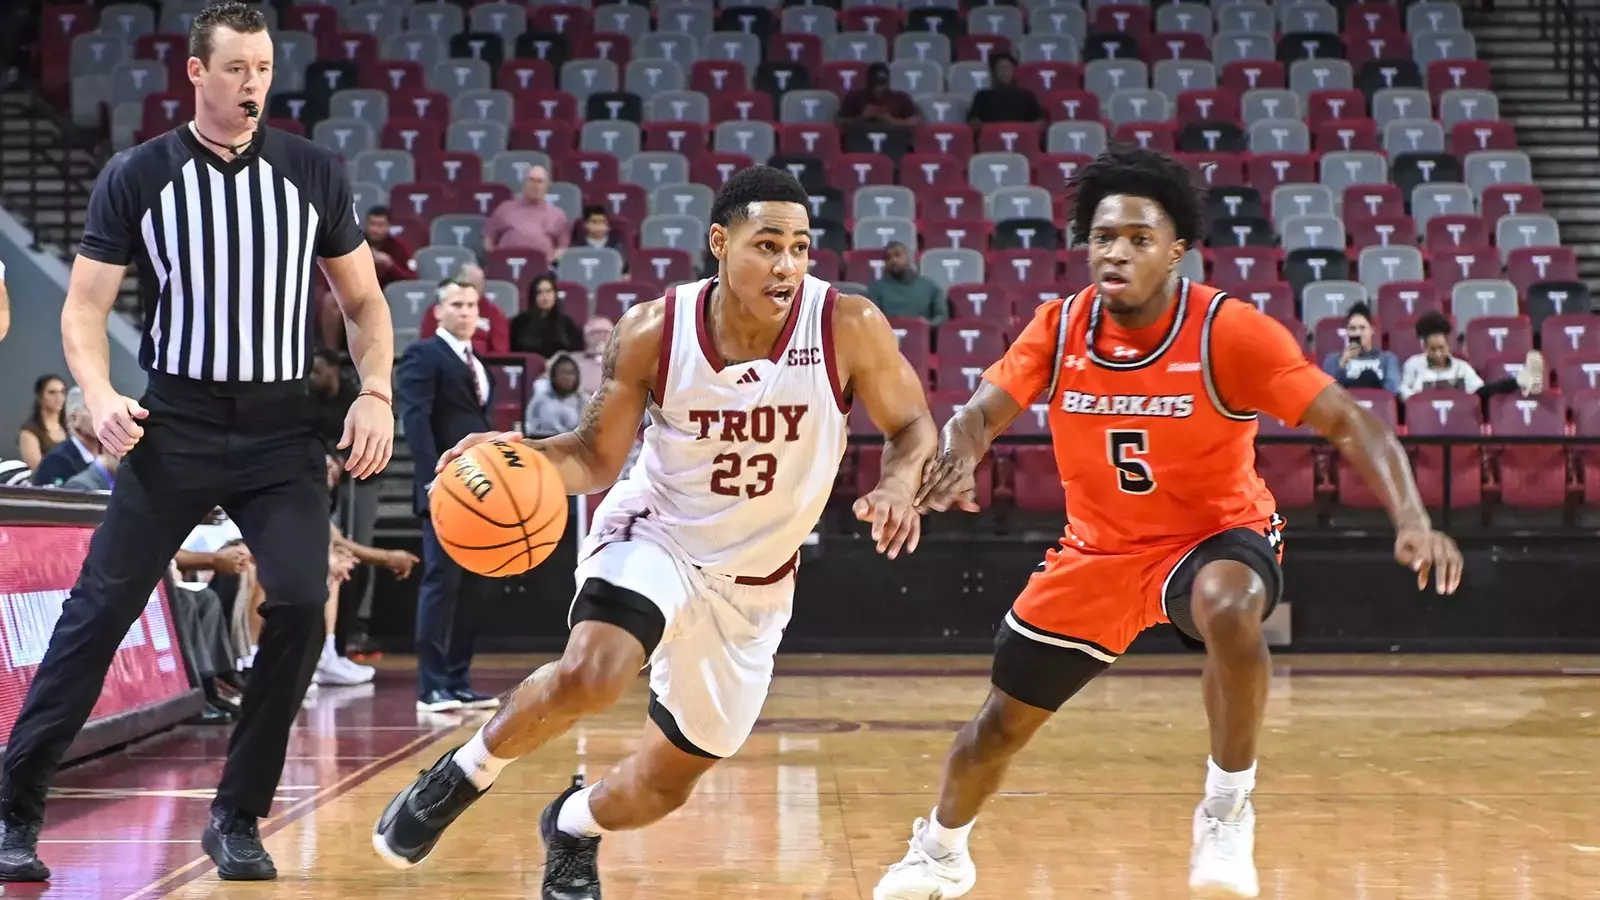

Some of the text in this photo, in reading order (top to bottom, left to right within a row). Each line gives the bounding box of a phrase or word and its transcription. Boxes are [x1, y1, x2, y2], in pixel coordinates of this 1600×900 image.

[131, 69, 148, 88] T
[324, 70, 341, 89] T
[389, 70, 405, 88] T
[454, 67, 471, 85] T
[516, 69, 533, 88] T
[581, 69, 597, 87] T
[645, 68, 662, 86] T
[711, 70, 728, 89] T
[774, 70, 792, 89] T
[839, 70, 857, 89] T
[905, 70, 922, 89] T
[970, 71, 988, 88] T
[1039, 70, 1056, 89] T
[1107, 69, 1125, 87] T
[1177, 69, 1193, 87] T
[1244, 68, 1262, 87] T
[1312, 68, 1330, 87] T
[1380, 68, 1398, 87] T
[1449, 68, 1467, 87] T
[162, 100, 179, 119] T
[287, 100, 305, 119] T
[351, 99, 367, 118] T
[413, 98, 430, 117] T
[475, 99, 493, 120] T
[540, 100, 557, 119] T
[605, 100, 624, 119] T
[671, 101, 689, 119] T
[736, 101, 754, 120] T
[801, 98, 819, 117] T
[932, 102, 950, 121] T
[1063, 100, 1081, 119] T
[1129, 98, 1147, 117] T
[1196, 99, 1213, 118] T
[1263, 99, 1281, 118] T
[1327, 99, 1345, 118] T
[1393, 97, 1411, 117] T
[1460, 99, 1478, 118] T
[334, 129, 352, 148] T
[400, 130, 418, 150] T
[467, 130, 486, 150] T
[534, 130, 552, 148] T
[602, 131, 619, 150] T
[668, 131, 685, 150] T
[736, 131, 753, 151] T
[801, 132, 819, 151] T
[868, 132, 887, 153] T
[935, 133, 953, 152] T
[1000, 131, 1019, 152] T
[1068, 132, 1086, 151] T
[1135, 131, 1152, 149] T
[1203, 130, 1221, 151] T
[1271, 128, 1289, 149] T
[1337, 129, 1356, 150] T
[1405, 129, 1424, 149] T
[1474, 128, 1492, 149] T
[374, 160, 394, 181] T
[443, 161, 461, 180] T
[580, 161, 599, 181] T
[649, 162, 668, 181] T
[717, 164, 735, 183] T
[853, 163, 872, 183] T
[921, 163, 940, 183] T
[989, 164, 1008, 183] T
[1271, 161, 1290, 181] T
[1344, 161, 1362, 182] T
[1417, 161, 1436, 182] T
[1488, 161, 1506, 182] T
[409, 194, 428, 214] T
[474, 193, 493, 213] T
[608, 193, 626, 214] T
[674, 195, 693, 217] T
[807, 196, 826, 216] T
[874, 197, 894, 220] T
[944, 197, 964, 218] T
[1012, 197, 1031, 216] T
[1224, 196, 1242, 216] T
[1293, 195, 1312, 217] T
[1364, 195, 1383, 215] T
[1434, 194, 1452, 213] T
[1503, 193, 1523, 214] T
[452, 225, 472, 246] T
[663, 227, 682, 247] T
[947, 229, 967, 250] T
[1016, 229, 1036, 249] T
[1232, 226, 1252, 248] T
[1304, 226, 1323, 246] T
[1375, 224, 1395, 245] T
[1447, 224, 1466, 245] T
[1518, 226, 1537, 246] T
[435, 256, 455, 277] T
[506, 258, 527, 279] T
[580, 258, 600, 279] T
[651, 258, 671, 279] T
[869, 260, 885, 280] T
[942, 259, 961, 279] T
[1012, 259, 1032, 280] T
[1235, 257, 1255, 279] T
[1308, 258, 1327, 279] T
[1381, 257, 1401, 278] T
[1455, 255, 1475, 277] T
[1532, 255, 1551, 278] T
[405, 292, 425, 313] T
[967, 293, 988, 315] T
[1251, 293, 1271, 316] T
[1325, 293, 1345, 314] T
[1399, 291, 1419, 313] T
[1476, 291, 1496, 314] T
[1548, 291, 1568, 315] T
[959, 330, 980, 352] T
[1488, 327, 1509, 351] T
[1564, 326, 1585, 349] T
[787, 348, 821, 366] SBC
[503, 366, 523, 389] T
[962, 368, 983, 391] T
[1581, 363, 1600, 389] T
[1061, 390, 1195, 418] BEARKATS
[1432, 400, 1454, 424] T
[1516, 400, 1538, 424] T
[689, 404, 809, 443] TROY
[1030, 404, 1049, 427] T
[1105, 428, 1157, 495] 5
[710, 452, 777, 499] 23
